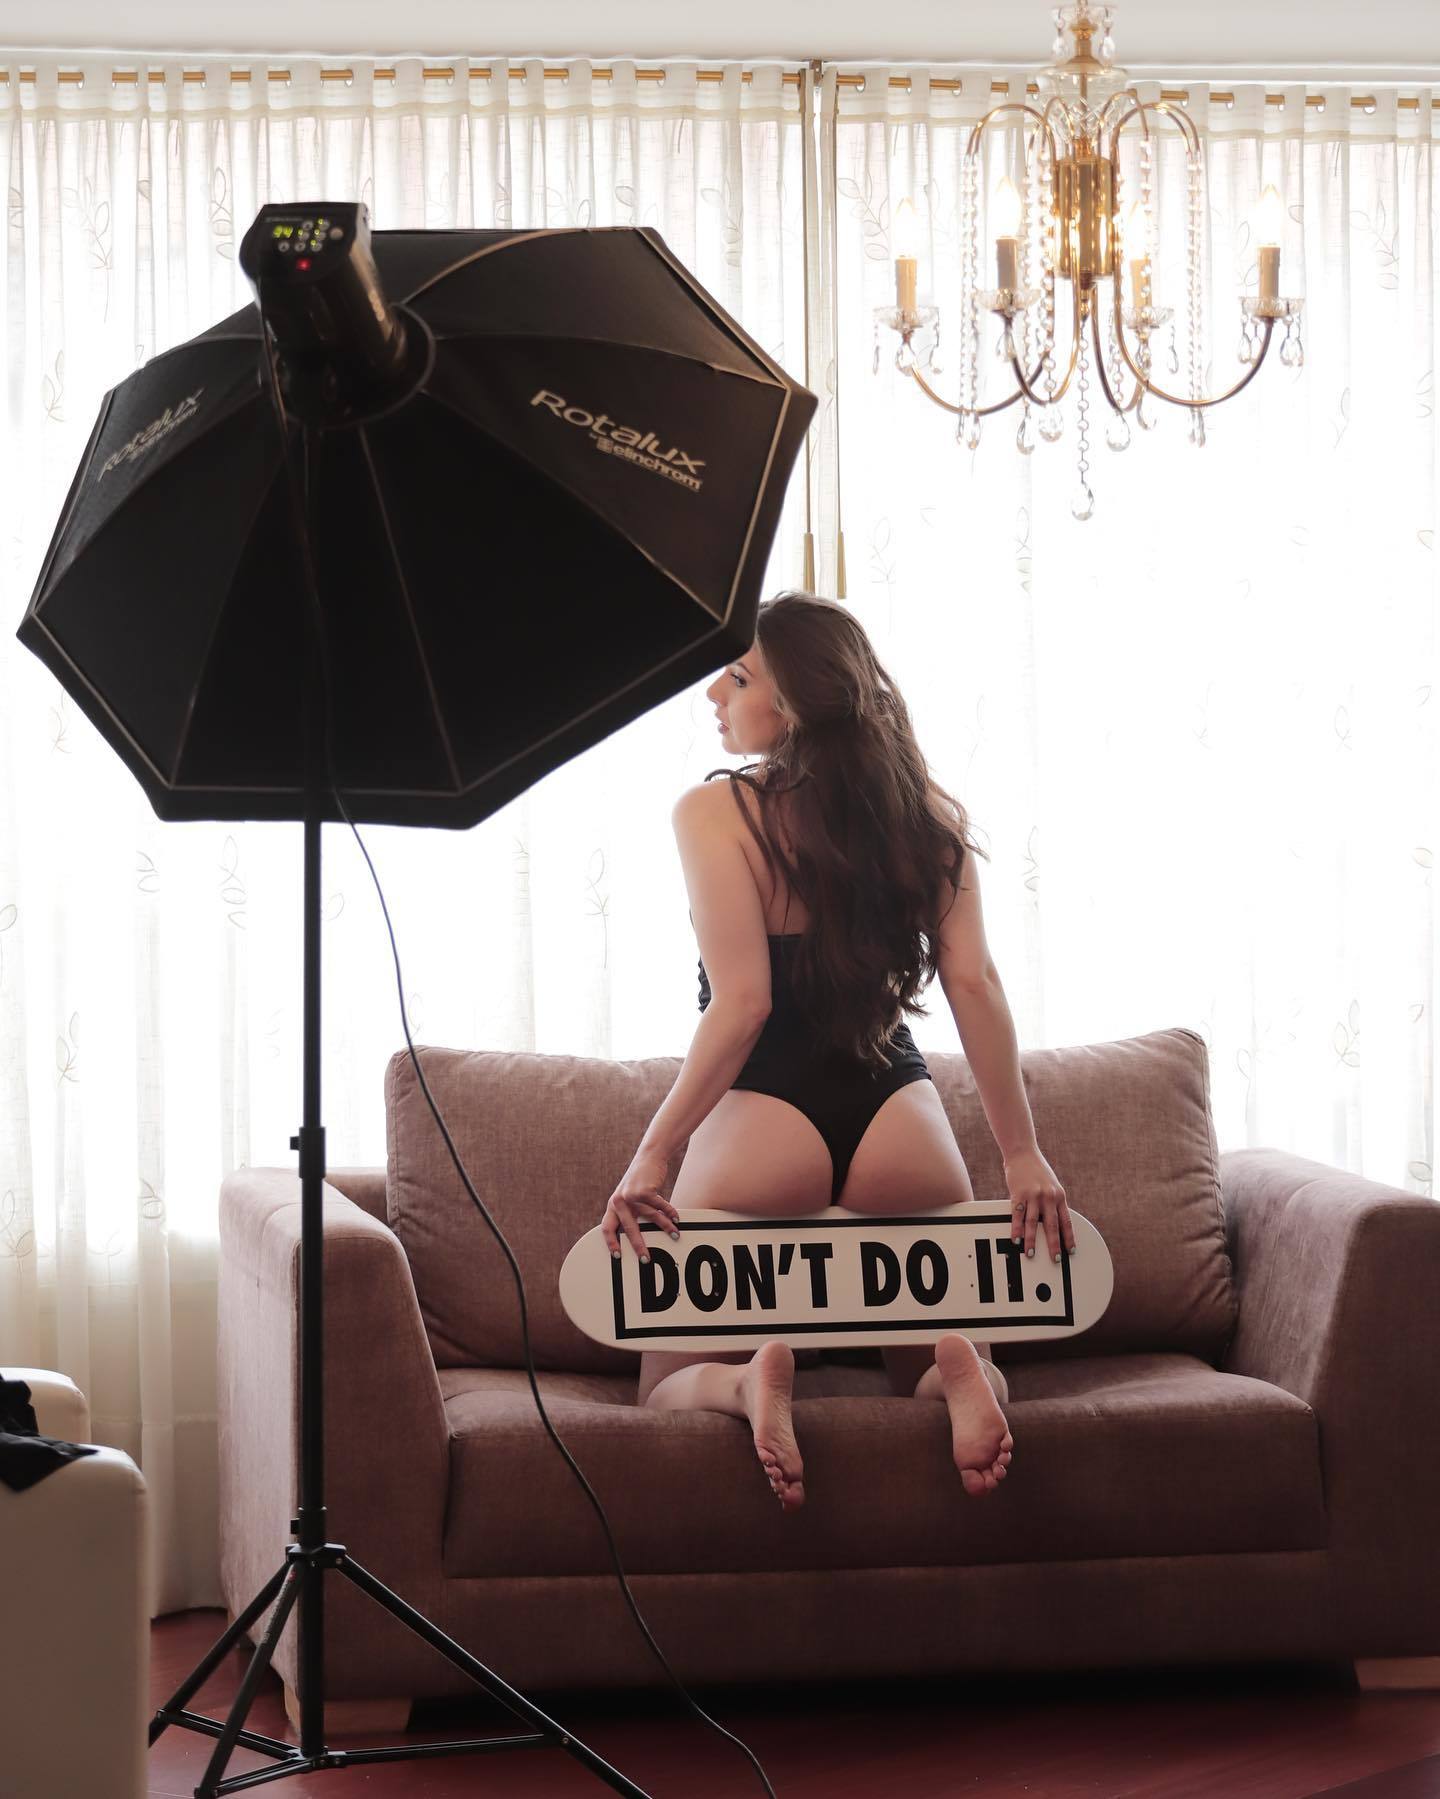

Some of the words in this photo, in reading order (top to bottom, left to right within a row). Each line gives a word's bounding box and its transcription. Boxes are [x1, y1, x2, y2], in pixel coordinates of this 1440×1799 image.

[530, 389, 706, 475] Rotalux
[612, 444, 703, 493] elinchrom
[638, 1242, 834, 1313] DON'T
[859, 1239, 949, 1307] DO
[974, 1238, 1052, 1304] IT.
